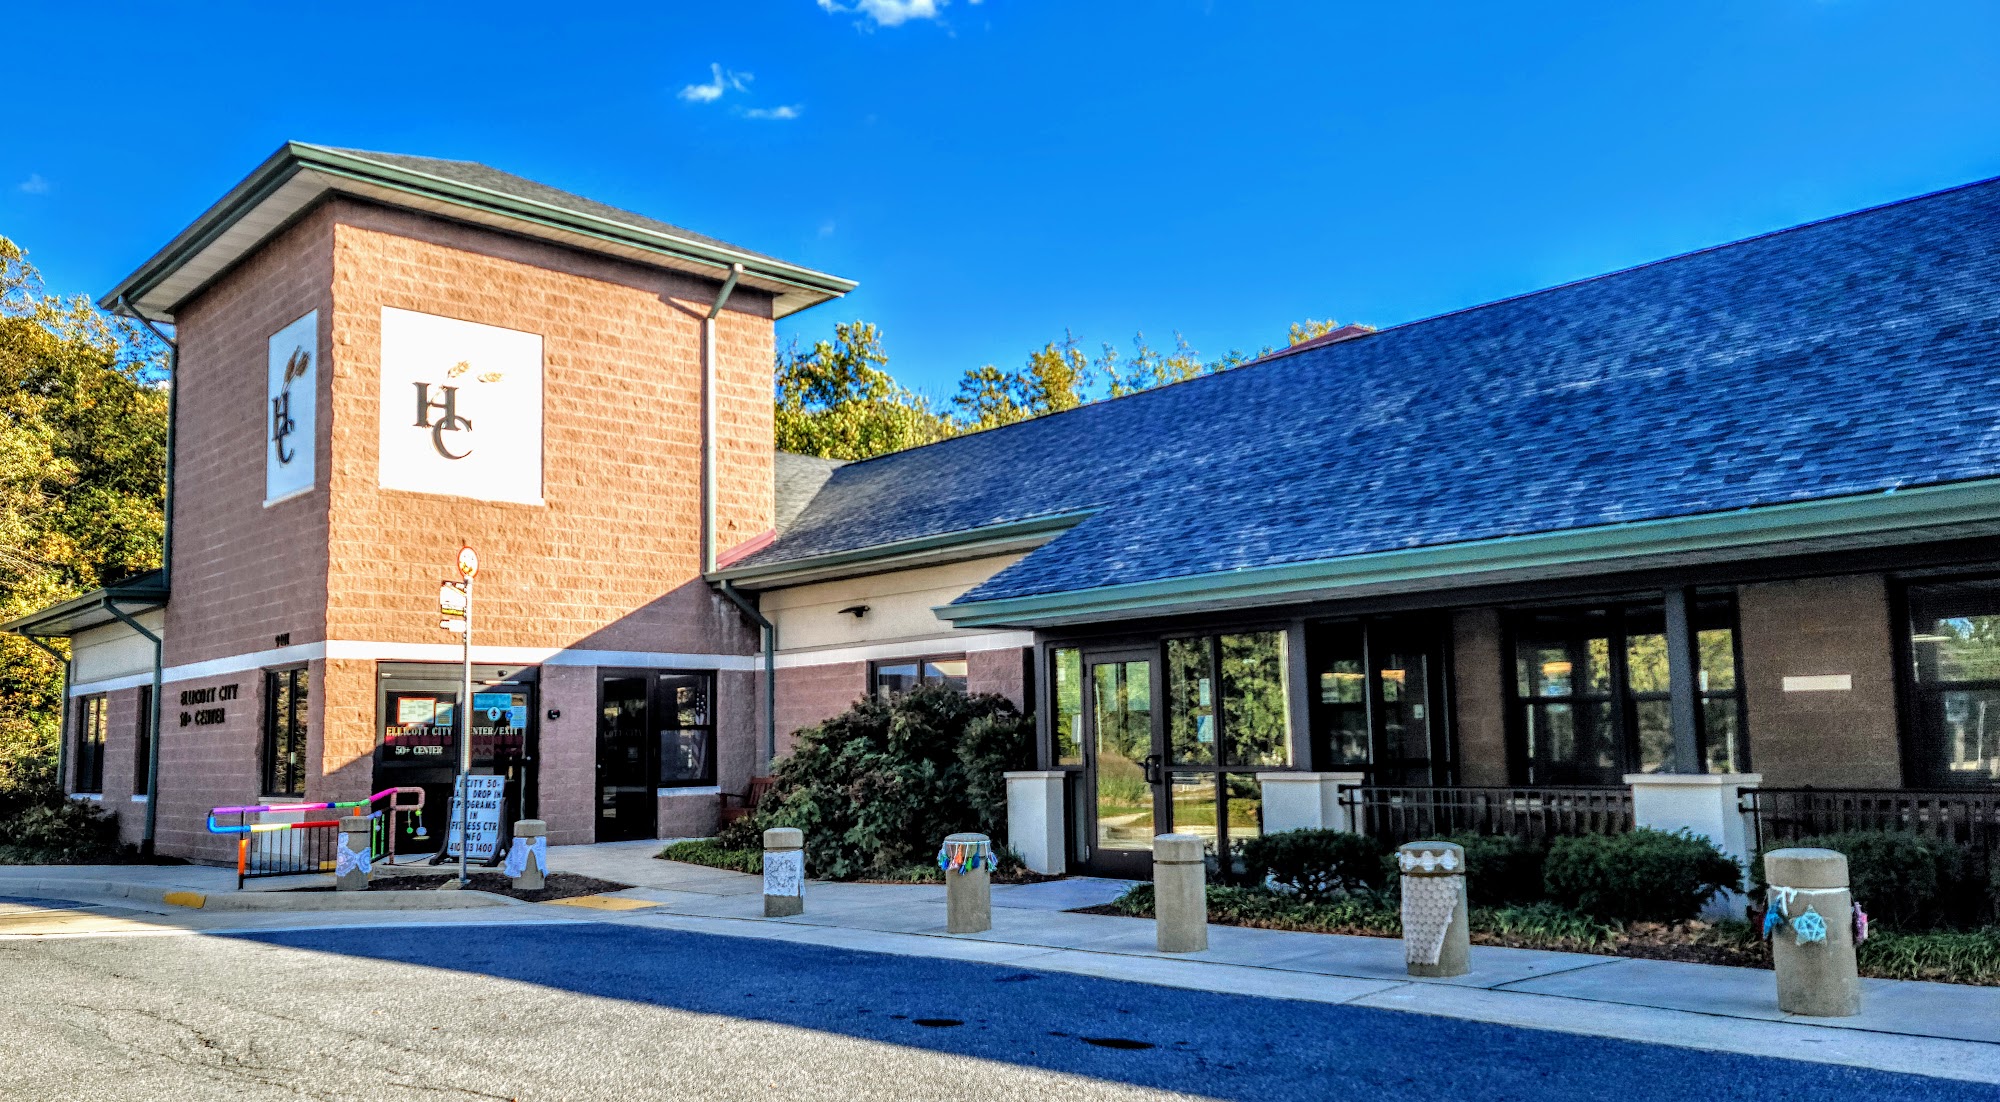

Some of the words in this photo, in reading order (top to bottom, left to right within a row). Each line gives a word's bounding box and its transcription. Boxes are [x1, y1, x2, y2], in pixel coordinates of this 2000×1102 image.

[218, 683, 239, 701] CITY
[194, 708, 225, 725] CENTER
[386, 726, 429, 736] ELLICOTT
[431, 726, 452, 736] CITY
[470, 726, 518, 736] NTER/EXIT
[395, 745, 411, 755] 50+
[413, 745, 443, 755] CENTER
[466, 779, 484, 788] CITY
[473, 789, 492, 798] DROP
[456, 800, 497, 810] POGRAMS
[469, 811, 479, 820] IN
[451, 821, 481, 830] FITESS
[483, 821, 497, 831] CTR
[465, 832, 482, 841] NFO
[475, 842, 493, 853] 1400
